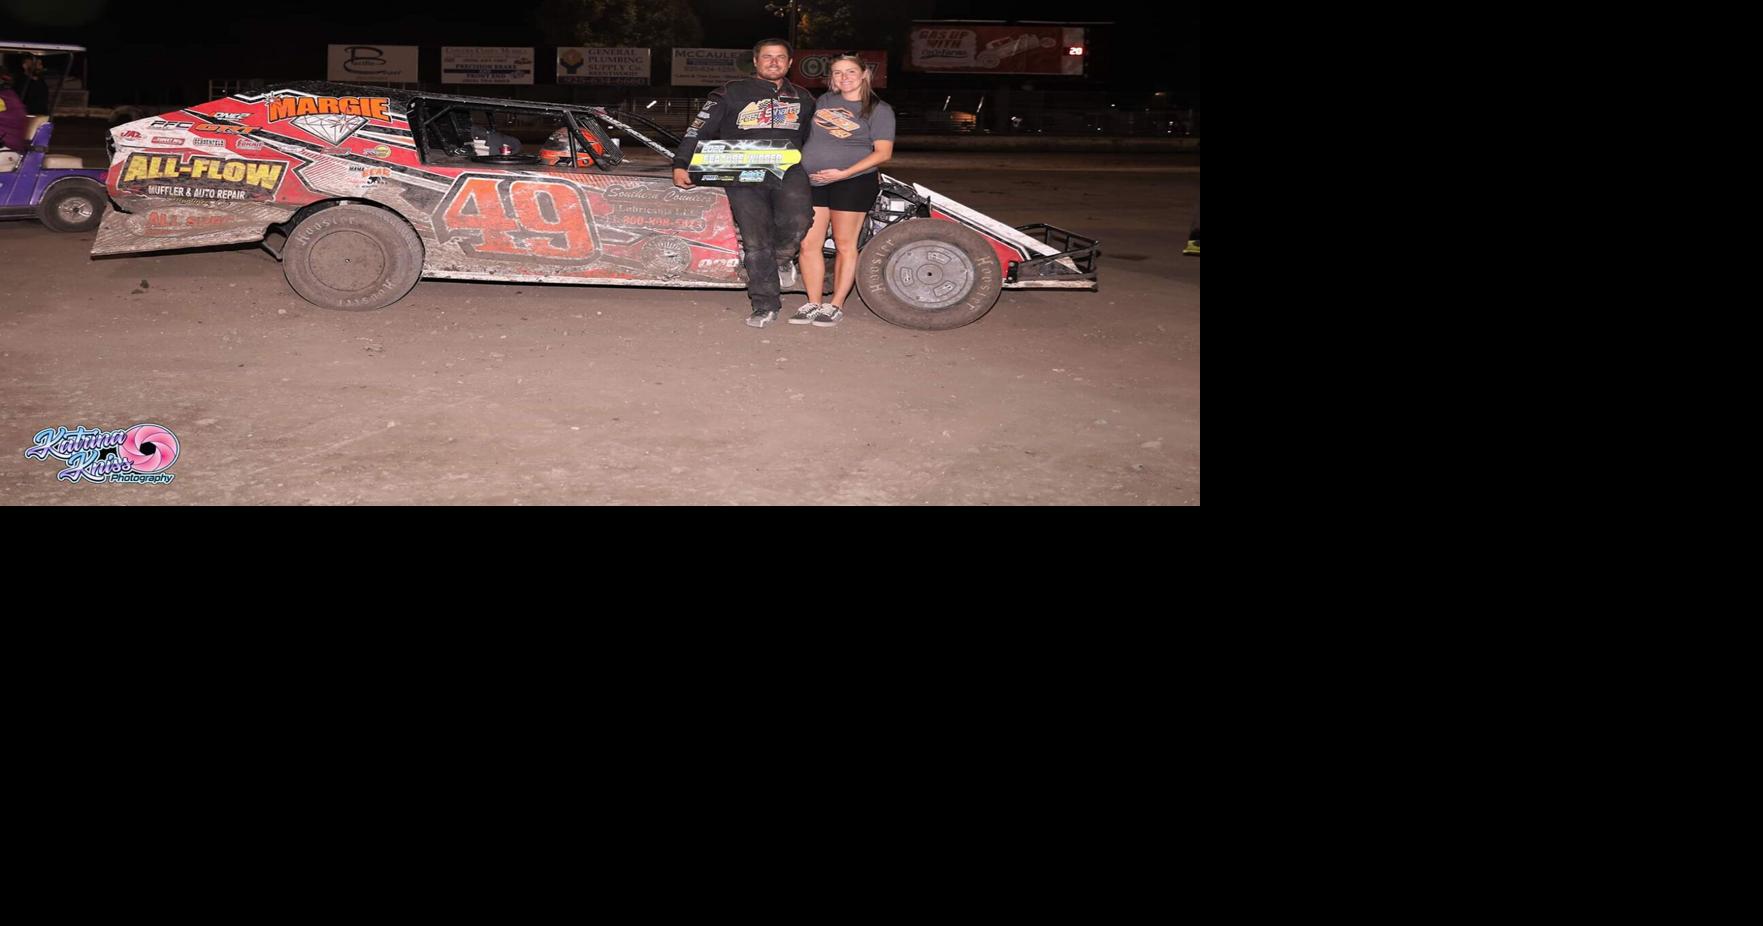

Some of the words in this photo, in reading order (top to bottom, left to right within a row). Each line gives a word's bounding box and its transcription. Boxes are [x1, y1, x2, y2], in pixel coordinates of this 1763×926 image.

[588, 48, 636, 56] GENERAL
[588, 56, 643, 64] PLUMBING
[267, 96, 392, 123] MARGIE
[123, 155, 282, 190] ALL-FLOW
[148, 185, 184, 197] MUFFLER
[185, 187, 192, 197] &
[194, 188, 215, 198] AUTO
[216, 189, 246, 200] REPAIR
[443, 177, 596, 260] 49
